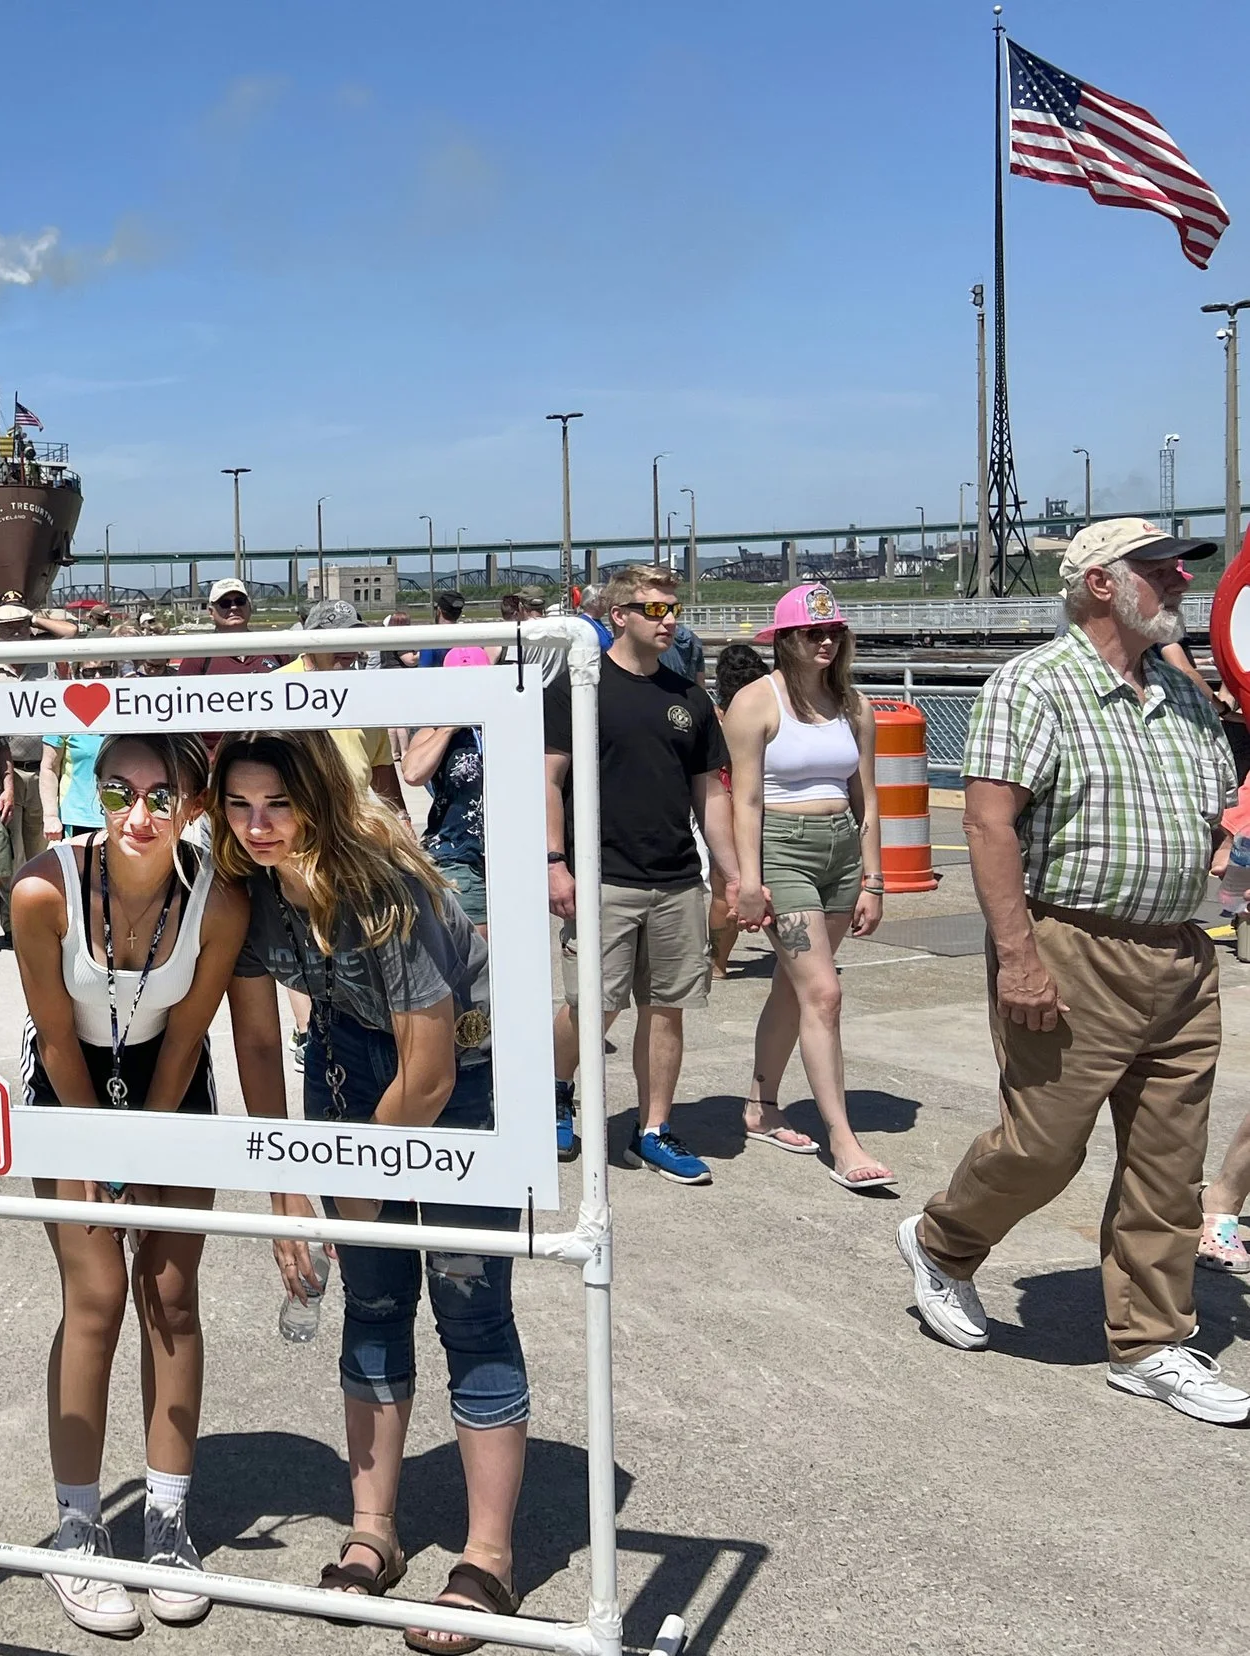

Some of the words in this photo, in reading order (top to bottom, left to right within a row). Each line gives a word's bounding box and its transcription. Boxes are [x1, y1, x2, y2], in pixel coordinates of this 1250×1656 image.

[10, 502, 55, 526] TREGURTHA
[8, 690, 57, 718] We
[115, 685, 274, 722] Engineers
[285, 682, 349, 718] Day
[246, 1131, 476, 1182] #SooEngDay
